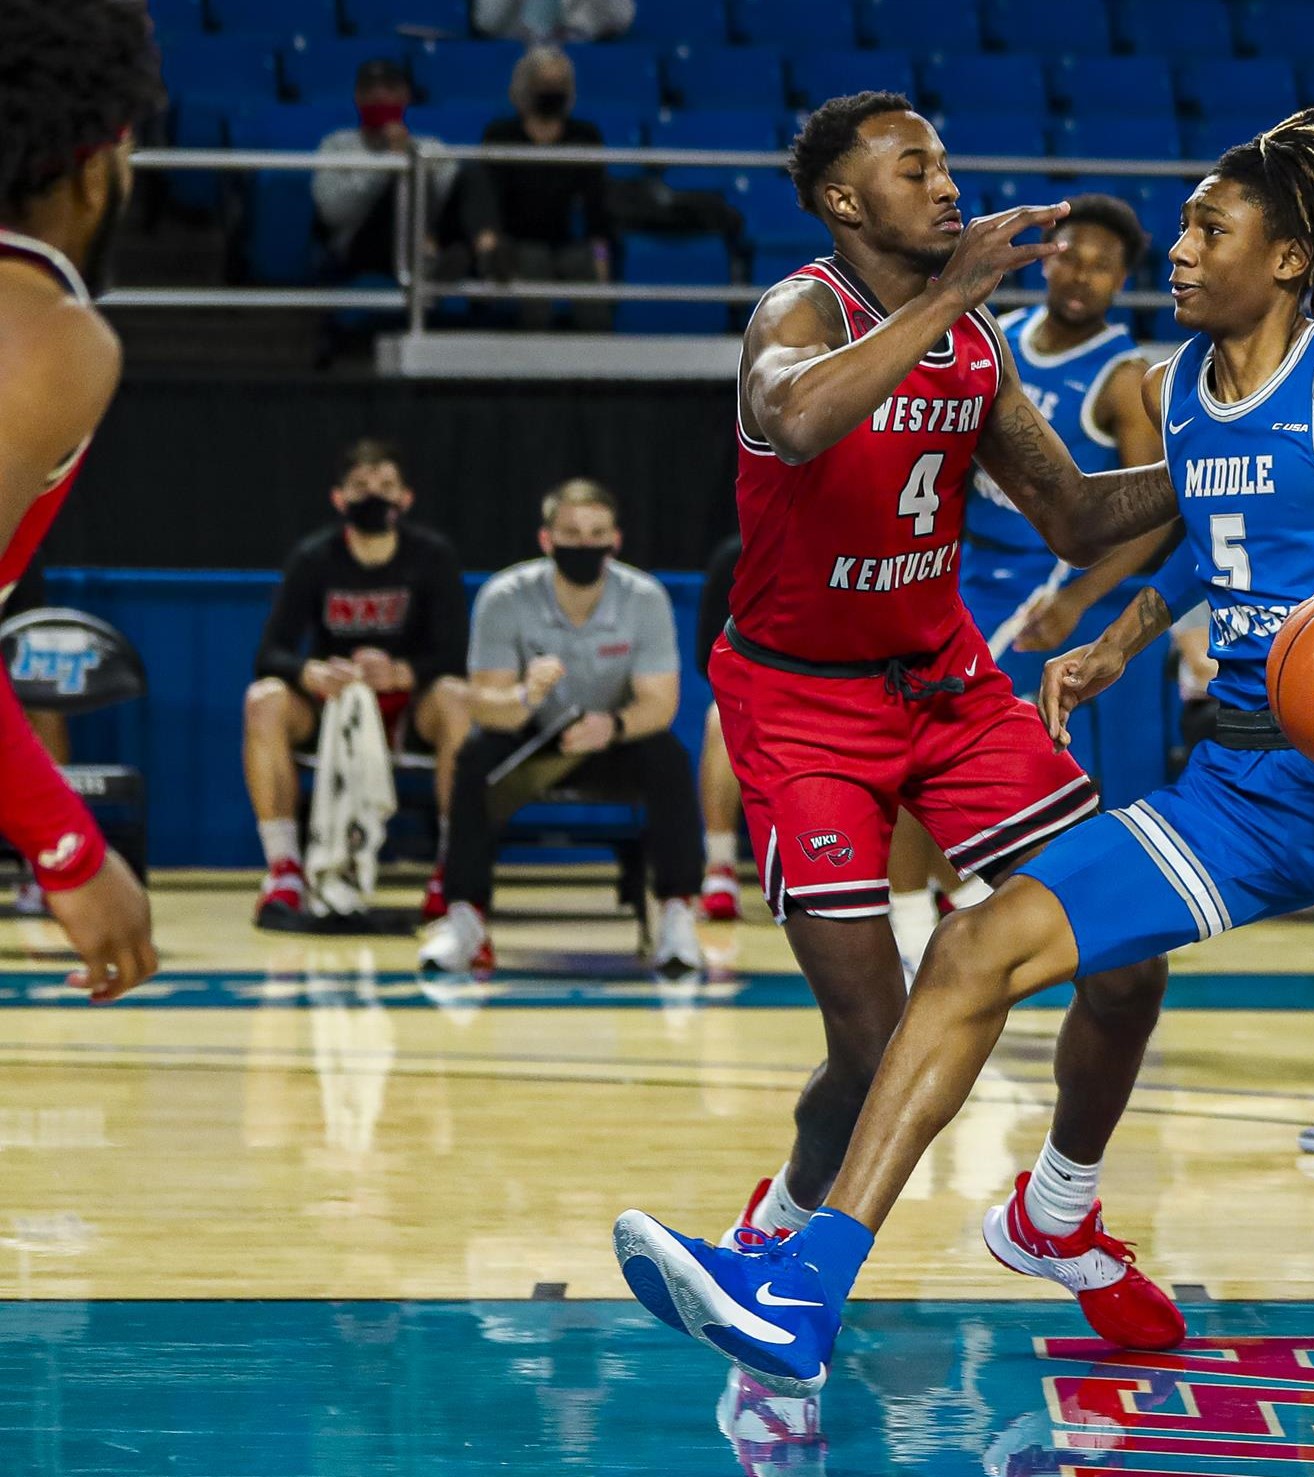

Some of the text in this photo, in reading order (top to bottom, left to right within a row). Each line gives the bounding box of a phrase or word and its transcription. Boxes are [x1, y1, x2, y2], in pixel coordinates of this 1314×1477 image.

[871, 395, 984, 433] WESTERN
[897, 451, 945, 538] 4
[1184, 454, 1276, 498] MIDDLE
[829, 540, 959, 592] KENTUCKY
[1209, 512, 1252, 592] 5
[810, 834, 838, 850] WKU
